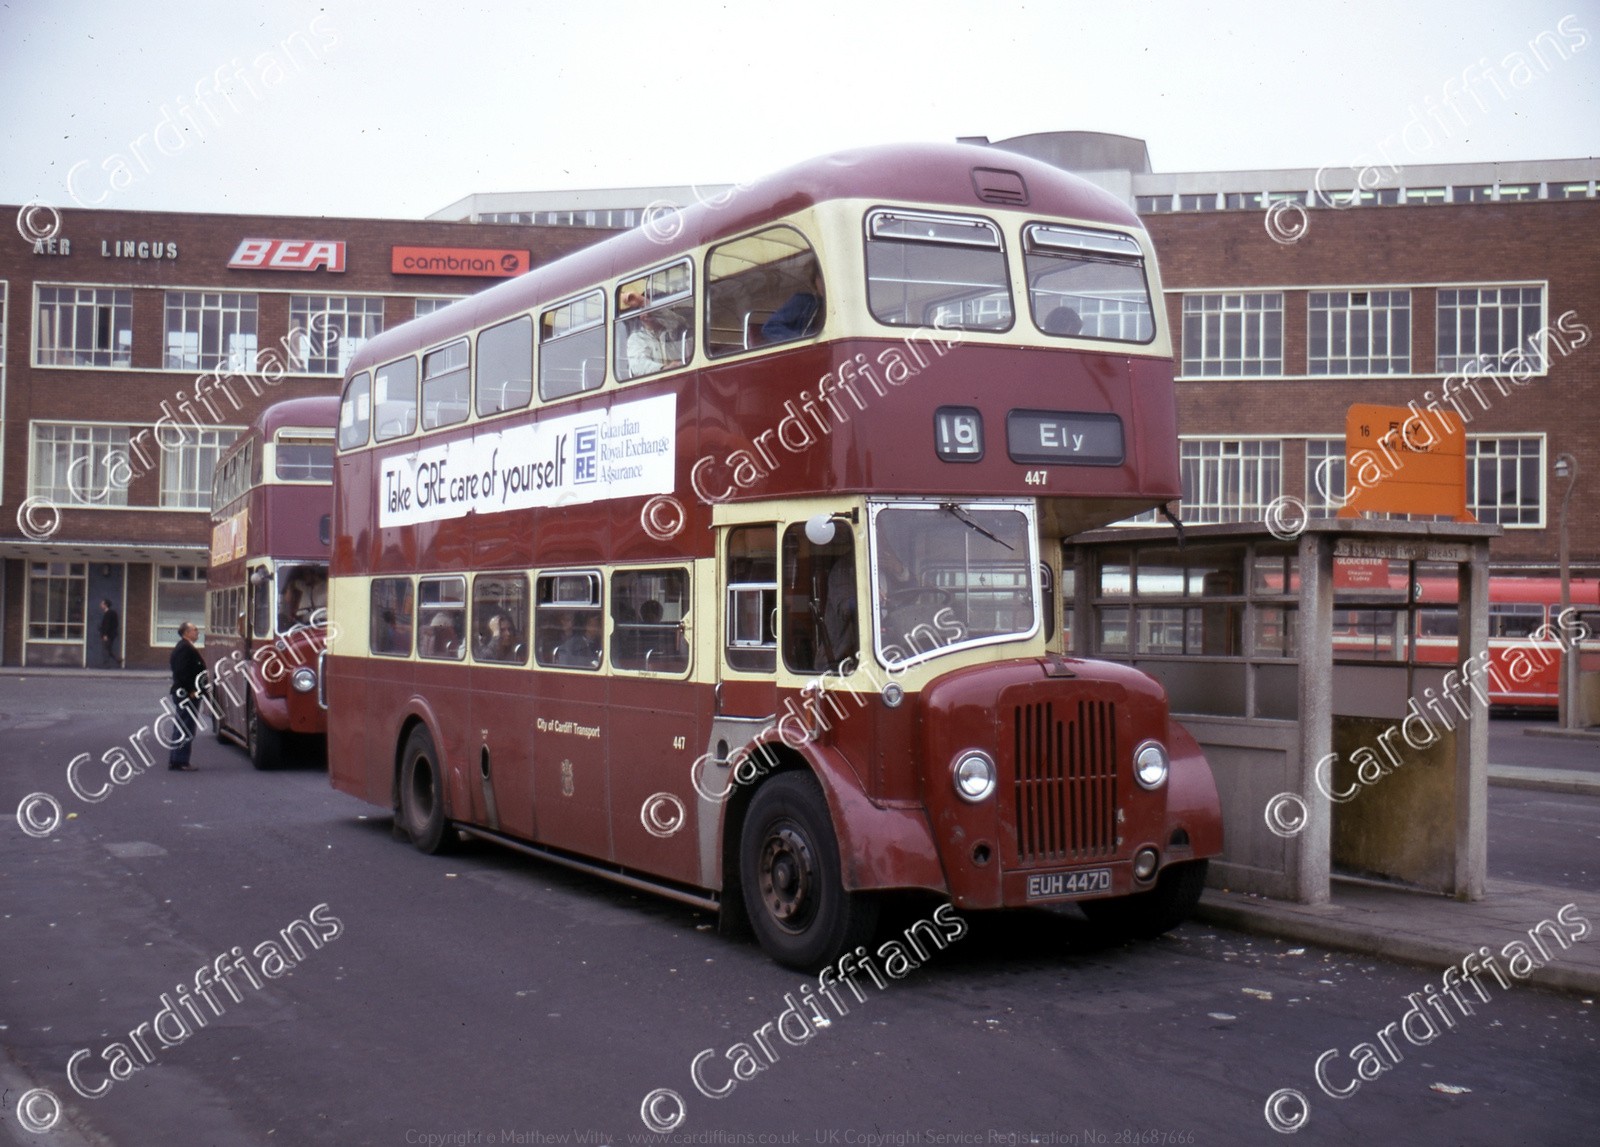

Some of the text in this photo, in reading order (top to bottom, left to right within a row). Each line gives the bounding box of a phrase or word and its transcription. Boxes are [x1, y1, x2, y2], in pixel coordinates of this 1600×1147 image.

[33, 238, 177, 260] AER LINGUS
[230, 239, 338, 269] BEA
[403, 255, 496, 272] cambrian
[600, 418, 640, 440] Guardian
[1039, 423, 1084, 452] Ely
[1360, 425, 1370, 437] 16
[600, 436, 670, 461] Royal Exchange
[386, 433, 568, 513] Take GRE care of yourself
[575, 456, 596, 480] RE
[600, 461, 643, 483] Assurance
[1024, 471, 1048, 486] 447
[1336, 557, 1383, 565] GLOUCESTER
[537, 717, 600, 740] City of Cardiff Transport
[673, 736, 686, 750] 447
[1029, 871, 1110, 895] EUH 447D
